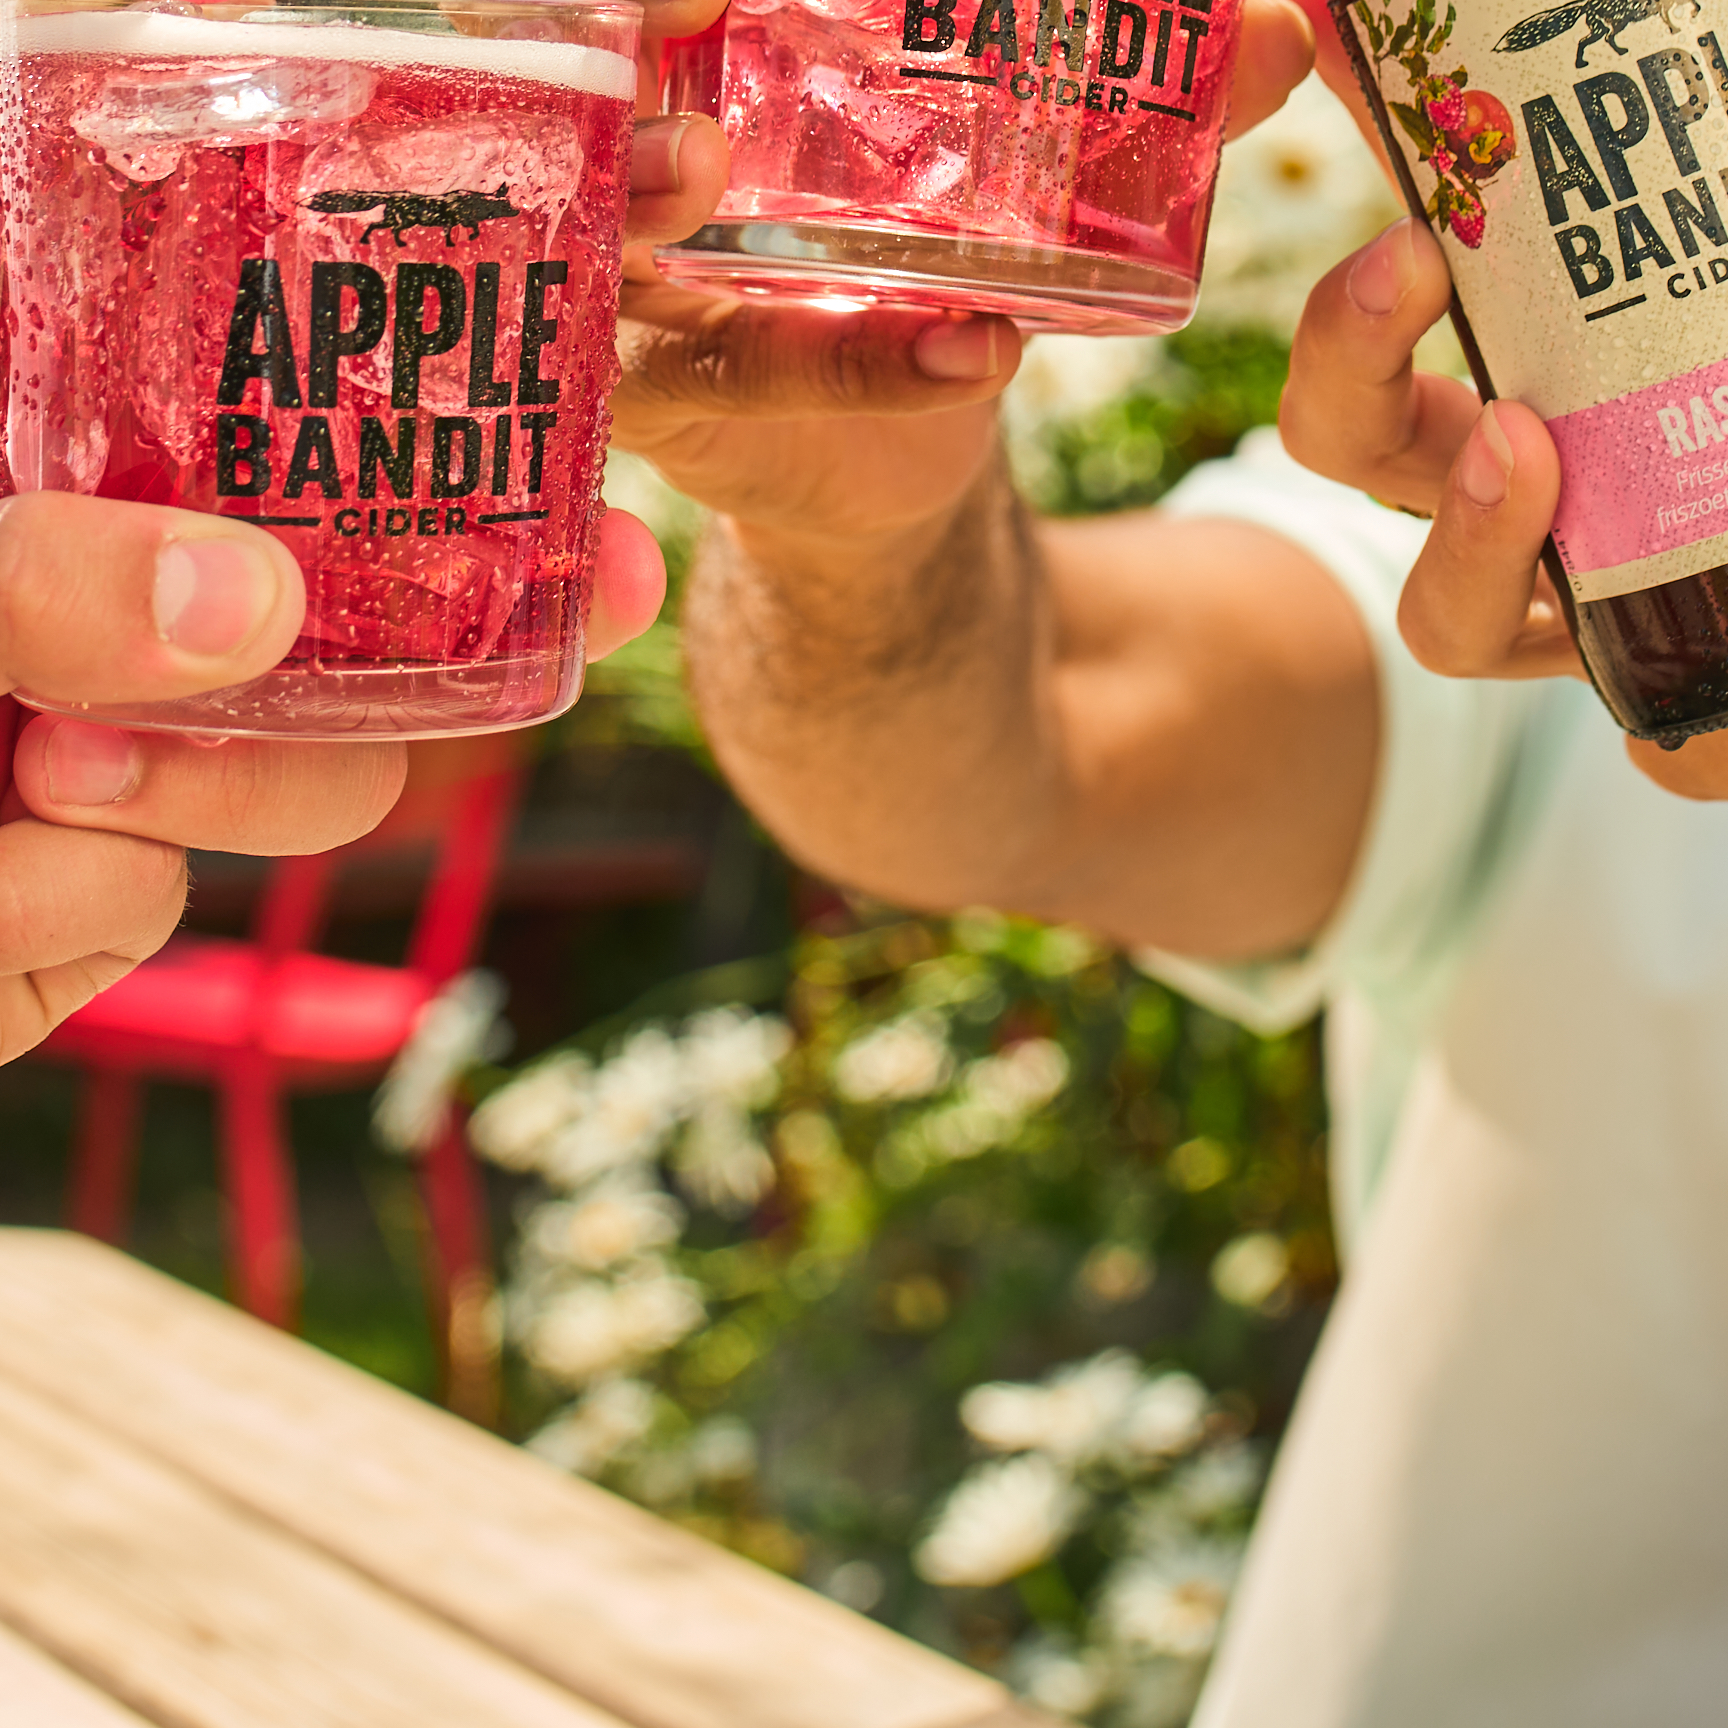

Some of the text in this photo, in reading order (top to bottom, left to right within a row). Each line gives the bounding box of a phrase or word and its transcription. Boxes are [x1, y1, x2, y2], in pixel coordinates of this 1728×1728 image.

[1009, 71, 1129, 115] CIDER
[216, 259, 568, 409] APPLE
[216, 411, 558, 500] BANDIT
[334, 507, 467, 537] CIDER
